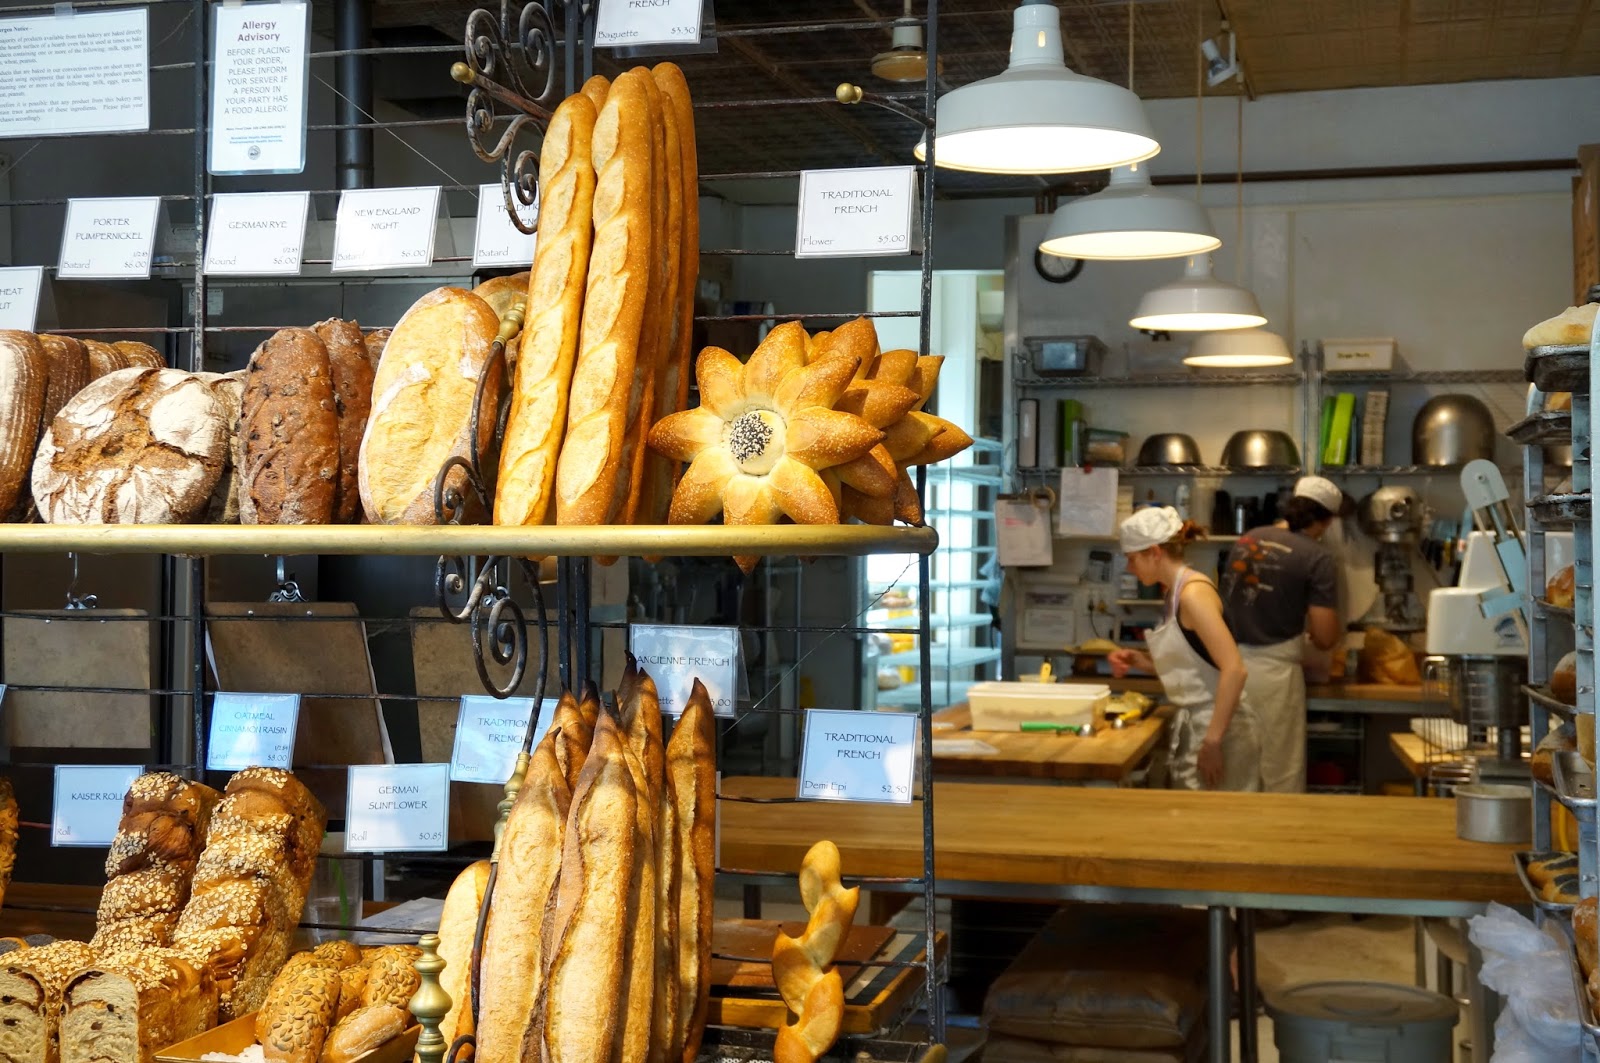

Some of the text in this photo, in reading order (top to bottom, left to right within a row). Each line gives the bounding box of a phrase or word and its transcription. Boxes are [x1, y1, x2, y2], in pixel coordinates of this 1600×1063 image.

[629, 0, 670, 8] FRENCH
[242, 21, 276, 30] Allergy
[237, 33, 280, 41] Advisory
[598, 31, 638, 41] Baguette
[227, 46, 290, 56] BEFORE PLACING
[255, 57, 283, 65] ORDER,
[249, 96, 270, 104] PARTY
[255, 105, 288, 113] ALLERGY.
[821, 189, 893, 199] TRADITIONAL
[376, 207, 420, 215] ENGLAND
[835, 205, 878, 214] FRENCH
[93, 218, 130, 226] PORTER
[228, 221, 267, 229] GERMAN
[370, 222, 399, 230] NIGHT
[75, 232, 143, 240] PUMPERNICKEL
[803, 234, 905, 245] Flower $5.00
[479, 246, 509, 257] Batard
[63, 260, 147, 269] Batard $6.00
[208, 256, 297, 265] Round $6.00
[637, 656, 730, 666] ANCIENNE FRENCH
[234, 712, 275, 720] OATMEAL
[478, 718, 543, 729] TRADITION
[219, 725, 287, 734] CINNAMON RAISIN
[824, 733, 896, 744] TRADITIONAL
[837, 750, 881, 759] FRENCH
[458, 763, 479, 772] Demi
[378, 785, 419, 794] GERMAN
[805, 780, 907, 794] Demi Epi $2.50
[369, 801, 427, 809] SUNFLOWER
[351, 831, 442, 841] Roll $0.85
